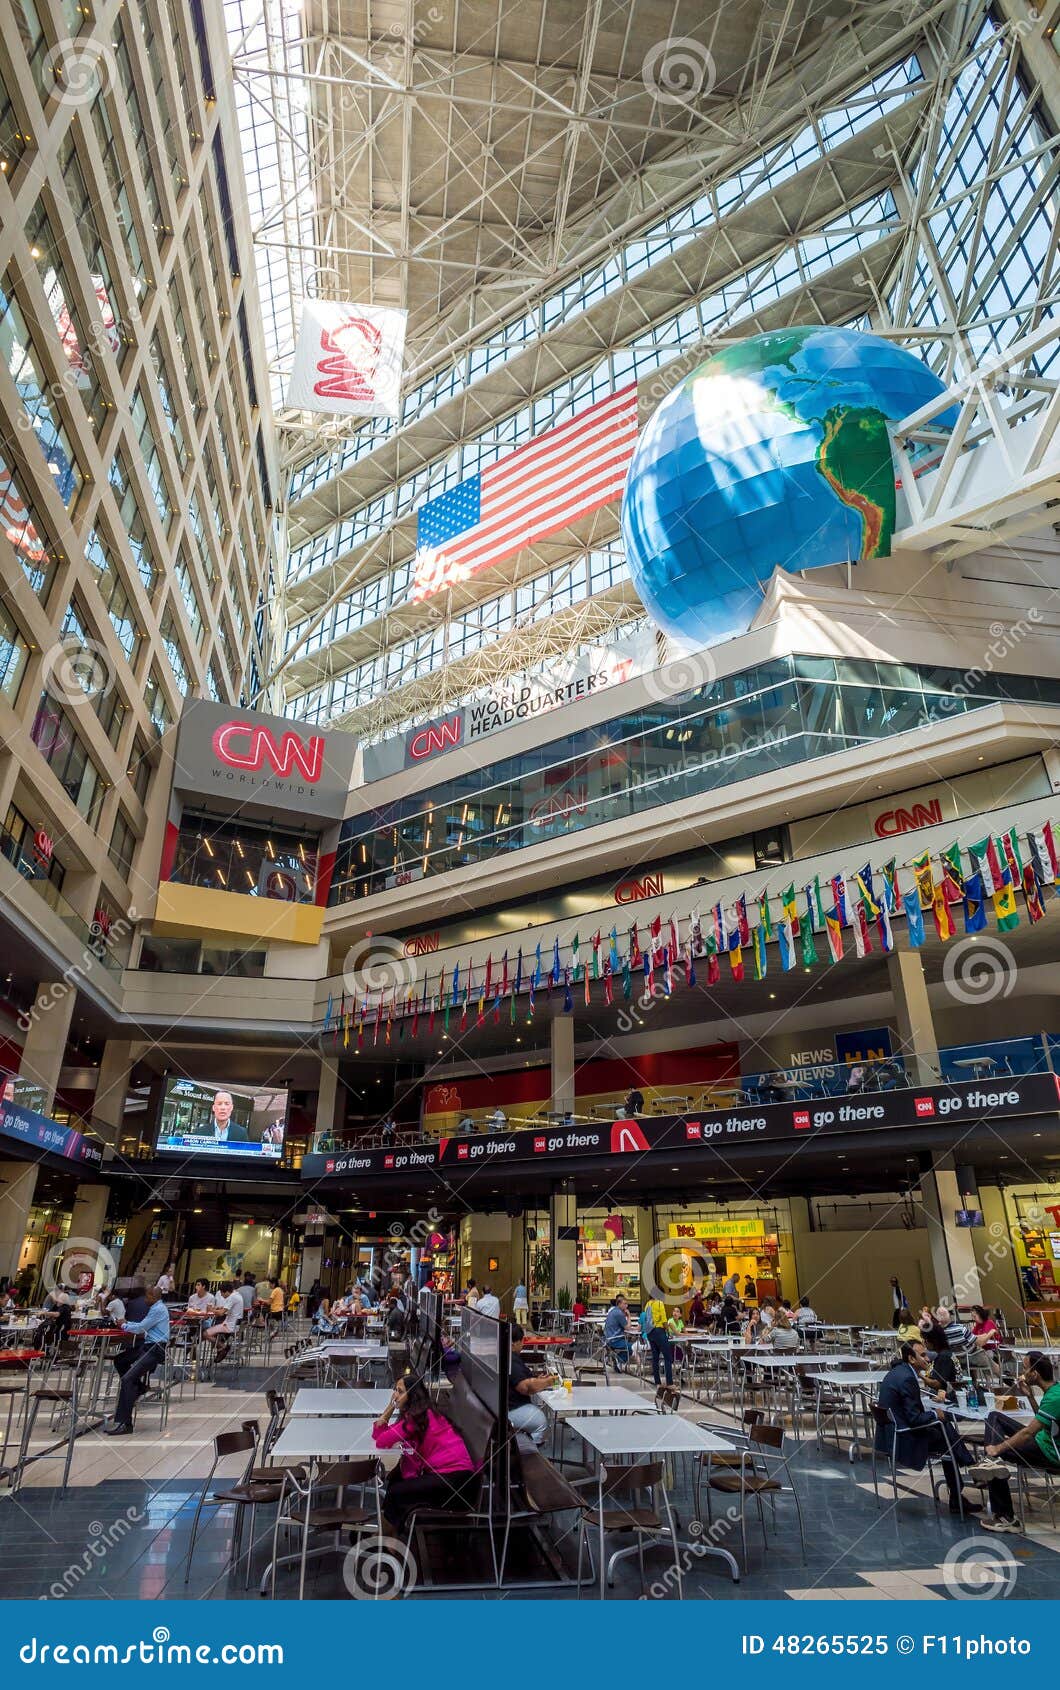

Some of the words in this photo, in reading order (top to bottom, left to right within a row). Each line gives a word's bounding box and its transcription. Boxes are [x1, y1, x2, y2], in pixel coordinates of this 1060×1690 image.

[470, 670, 608, 738] HEADQUARTERS
[471, 687, 531, 722] WORLD
[410, 716, 461, 761] CNN
[212, 720, 325, 784] CNN
[626, 724, 788, 797] NEWSROOM
[212, 769, 318, 797] WORLDWIDE
[529, 785, 588, 827] CNN
[874, 799, 943, 837] CNN
[395, 872, 411, 885] CNN
[615, 873, 664, 905] CNN
[403, 931, 440, 958] CNN
[790, 1049, 833, 1067] NEWS
[791, 1065, 835, 1083] VIEWS
[918, 1103, 932, 1111] CNN
[938, 1097, 962, 1114] go
[967, 1091, 1020, 1108] there
[3, 1115, 13, 1128] go
[13, 1117, 30, 1132] there
[813, 1111, 834, 1127] go
[839, 1105, 885, 1122] there
[43, 1131, 52, 1142] go
[52, 1130, 64, 1145] there
[704, 1121, 723, 1138] go
[726, 1117, 767, 1133] there
[470, 1145, 485, 1158] go
[486, 1141, 516, 1154] there
[548, 1138, 564, 1151] go
[566, 1133, 600, 1147] there
[85, 1148, 92, 1158] go
[91, 1148, 102, 1160] there
[335, 1161, 347, 1171] go
[348, 1157, 371, 1169] there
[395, 1155, 408, 1167] go
[410, 1153, 435, 1164] there
[700, 1224, 738, 1235] southwest
[740, 1221, 757, 1235] grill
